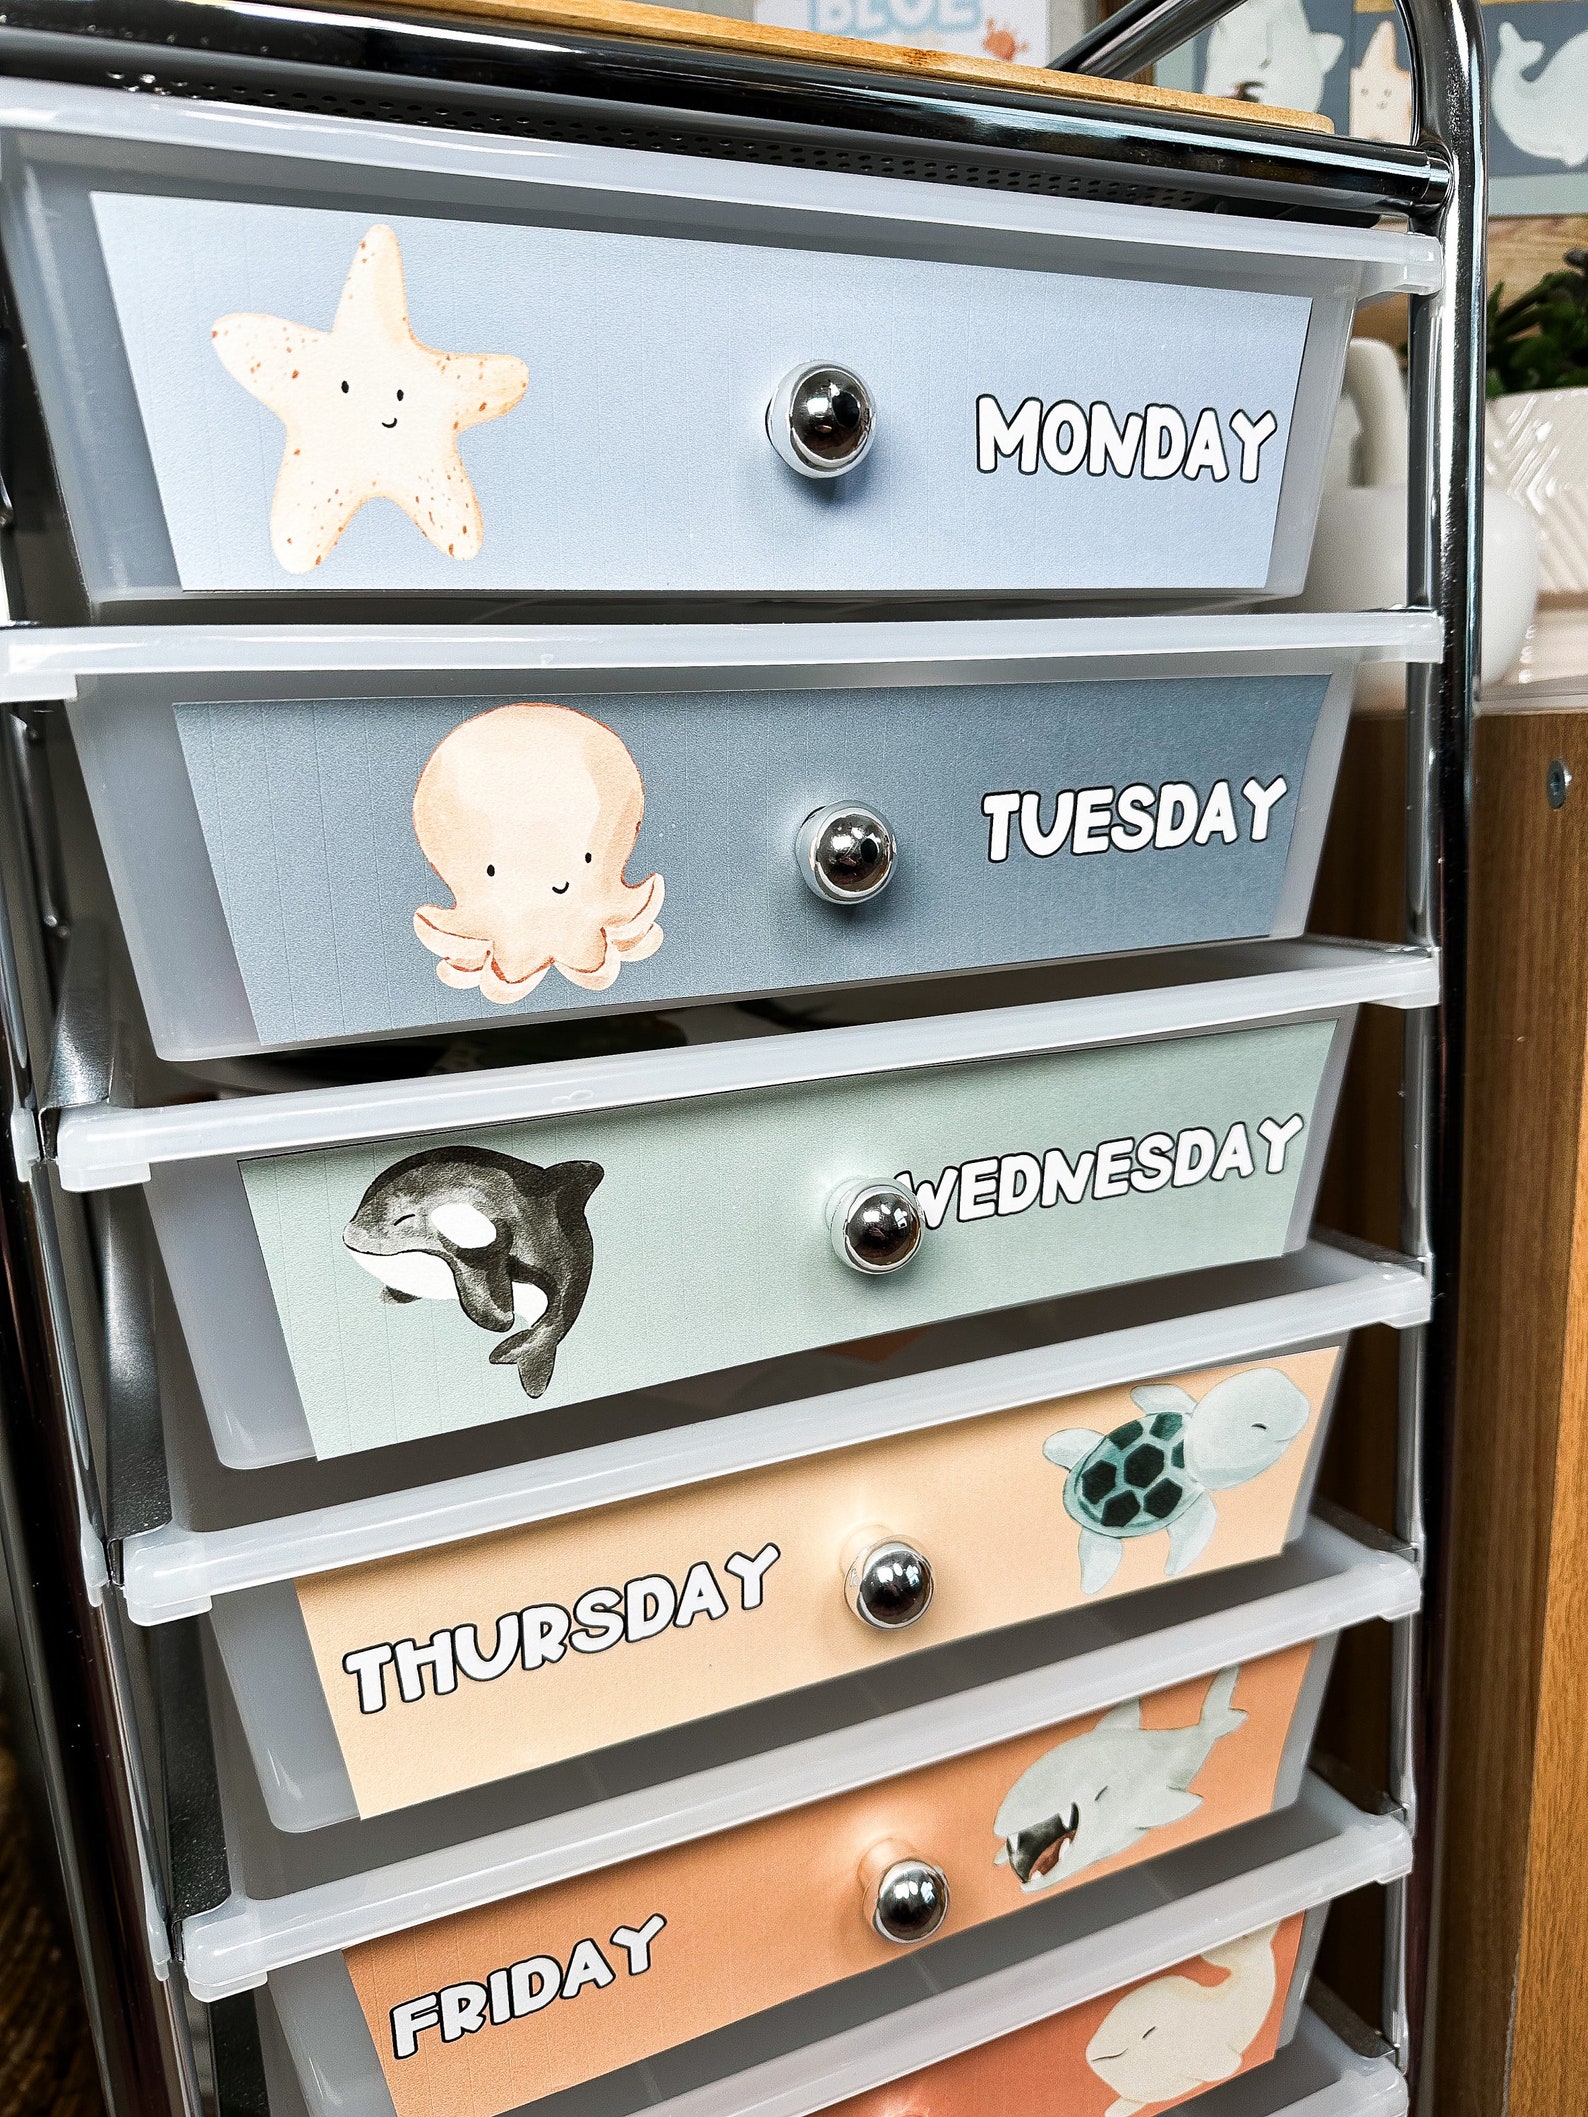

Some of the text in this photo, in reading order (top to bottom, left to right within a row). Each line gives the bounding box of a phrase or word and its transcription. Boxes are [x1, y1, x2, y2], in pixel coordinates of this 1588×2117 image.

[975, 394, 1278, 484] MONDAY
[981, 774, 1291, 864] TUESDAY
[342, 1542, 782, 1715] THURSDAY
[389, 1914, 669, 2061] FRIDAY
